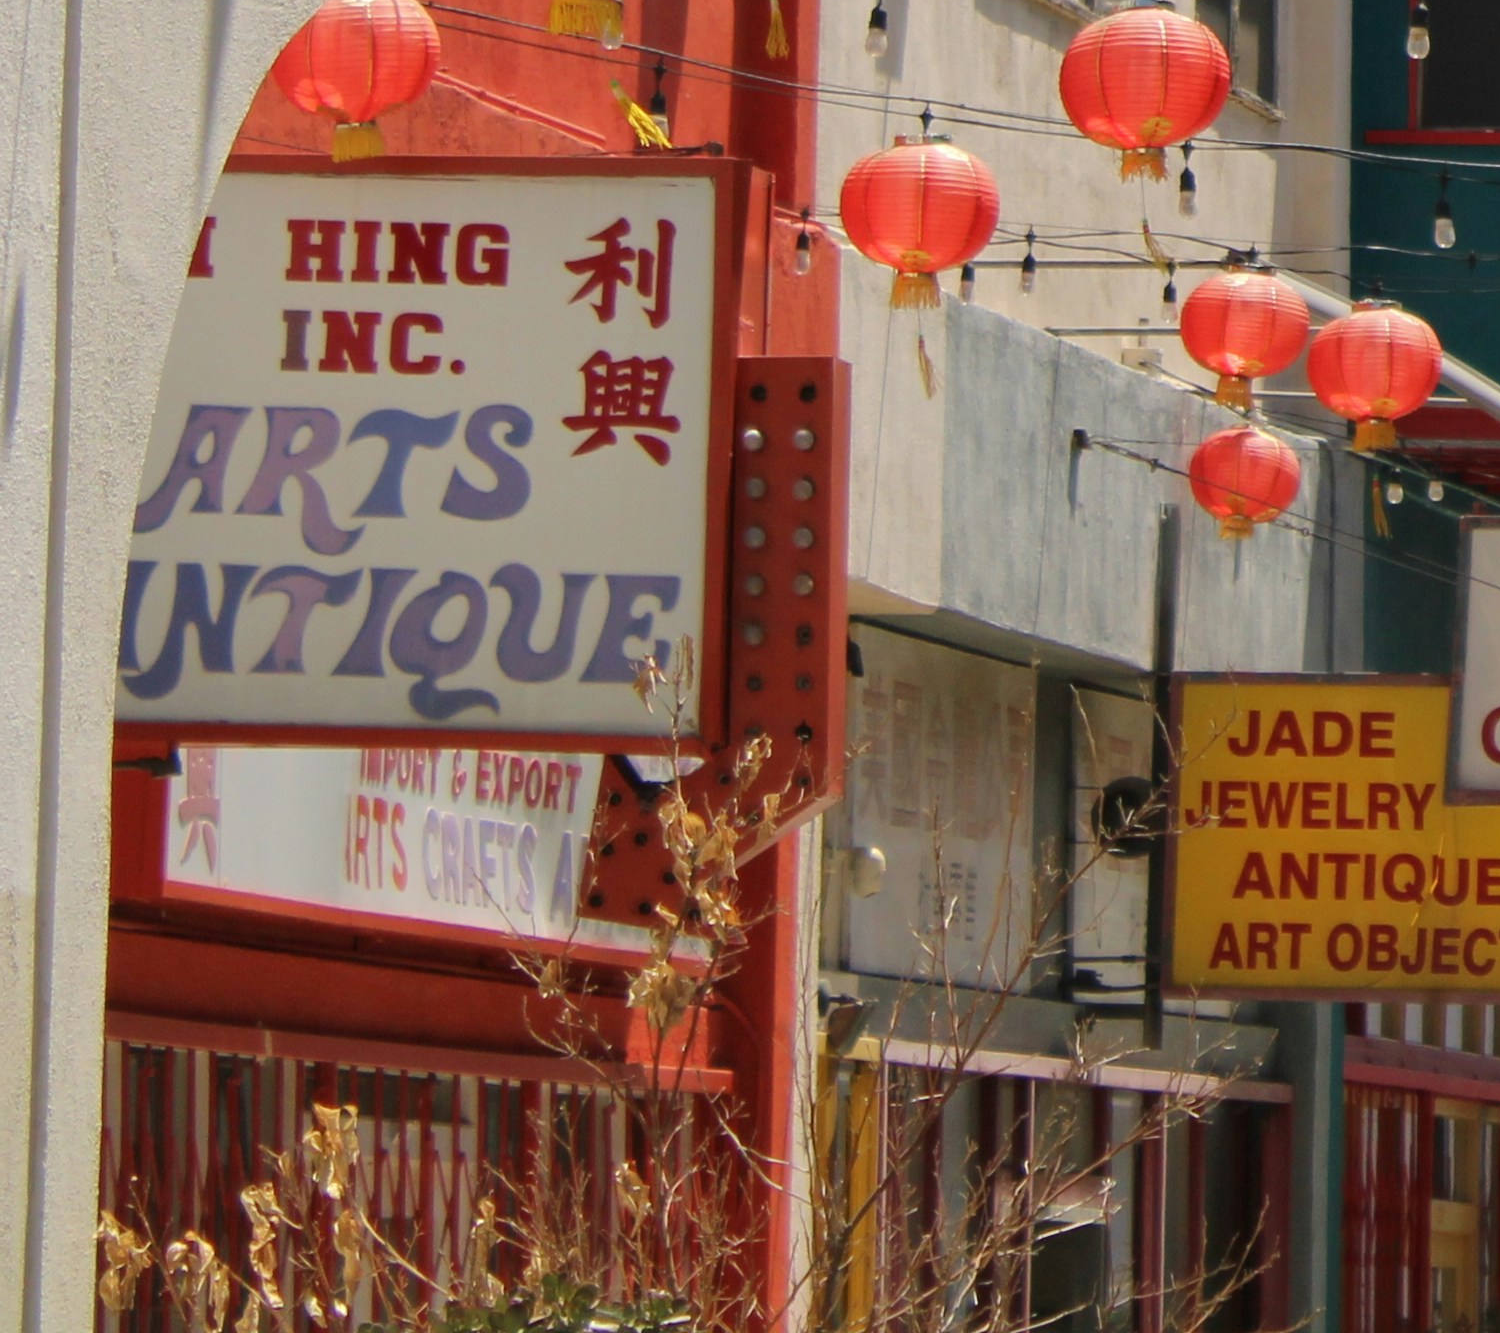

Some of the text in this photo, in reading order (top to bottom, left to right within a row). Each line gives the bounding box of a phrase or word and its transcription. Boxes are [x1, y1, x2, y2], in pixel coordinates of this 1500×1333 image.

[285, 219, 510, 286] HING
[280, 309, 466, 374] INC.
[561, 217, 681, 466] 利興
[132, 404, 533, 556] ARTS
[1228, 710, 1395, 758] JADE
[475, 751, 583, 813] EXPORT
[1185, 781, 1436, 831] JEWELRY
[423, 807, 537, 916] CRAFTS
[1209, 923, 1312, 970] ART
